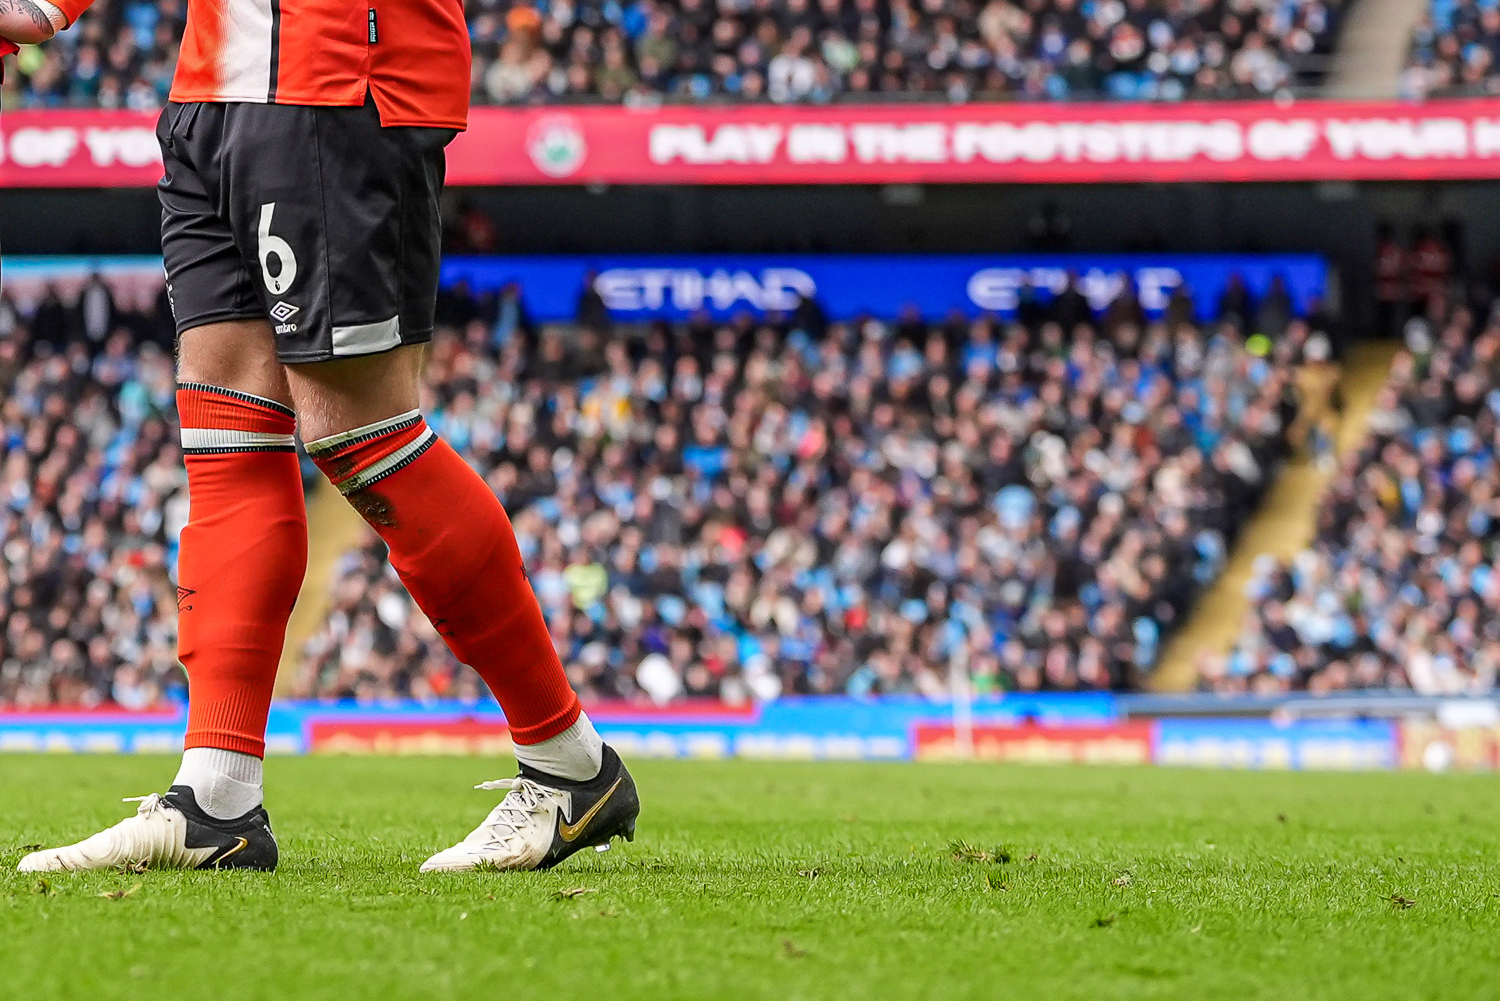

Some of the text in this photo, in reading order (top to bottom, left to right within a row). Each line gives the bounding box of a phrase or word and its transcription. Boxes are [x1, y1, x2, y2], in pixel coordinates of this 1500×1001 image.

[649, 125, 781, 164] PLAY
[851, 124, 946, 162] THE
[952, 121, 1244, 162] FOOTSTEPS
[1246, 120, 1317, 159] OF
[1325, 118, 1469, 158] YOUR
[258, 201, 297, 295] 6
